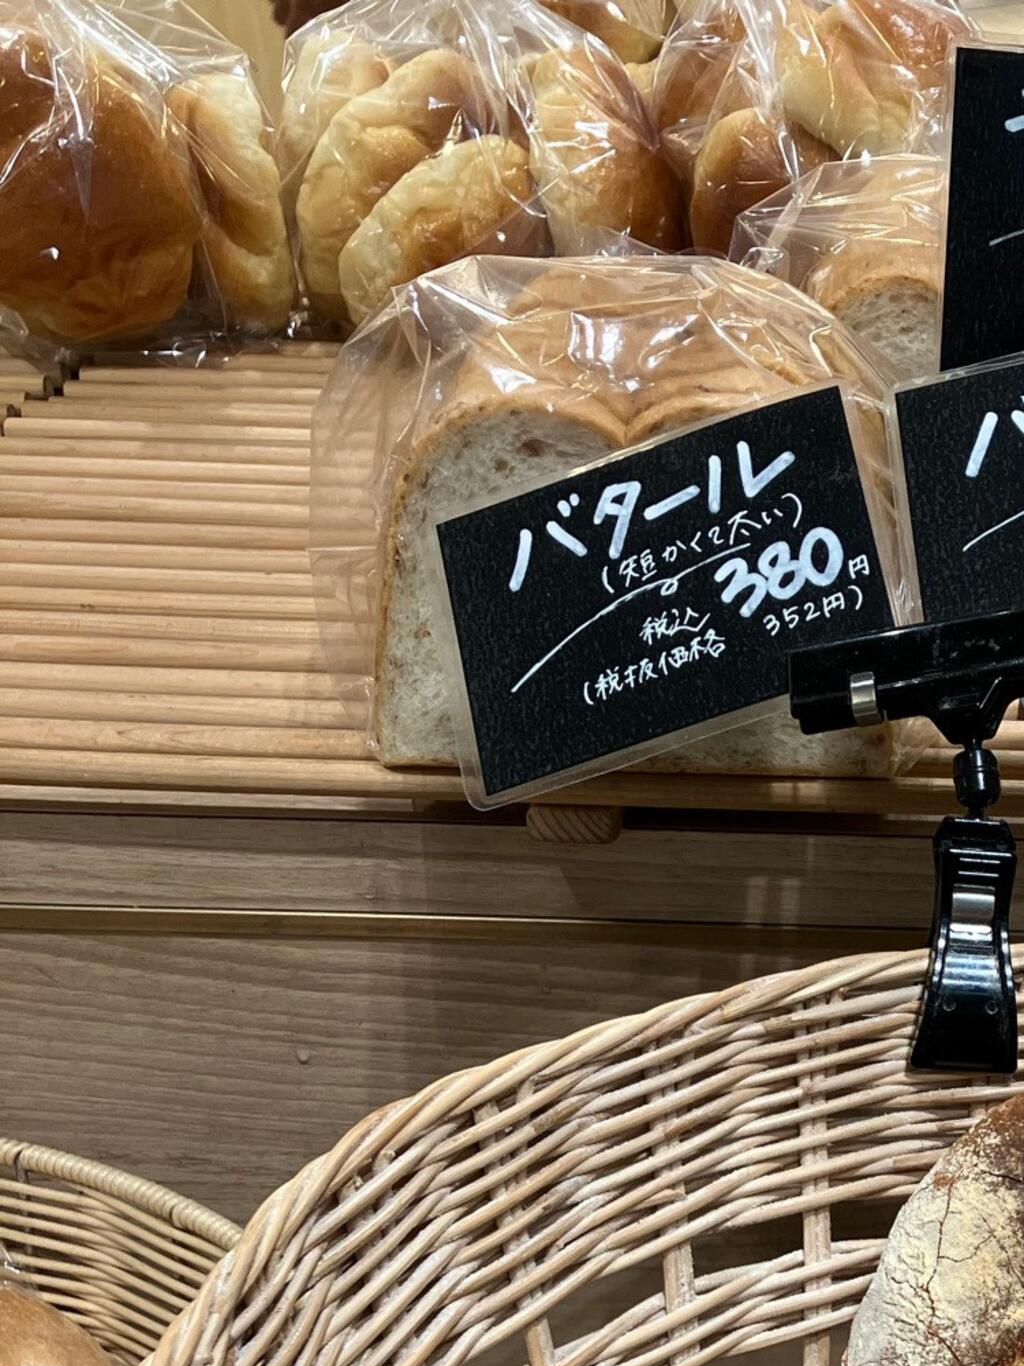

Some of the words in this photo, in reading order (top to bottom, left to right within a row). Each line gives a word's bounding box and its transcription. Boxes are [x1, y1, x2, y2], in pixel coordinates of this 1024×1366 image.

[509, 441, 796, 592] バタール
[601, 493, 802, 594] (短かくて太い)
[639, 606, 712, 645] 税込
